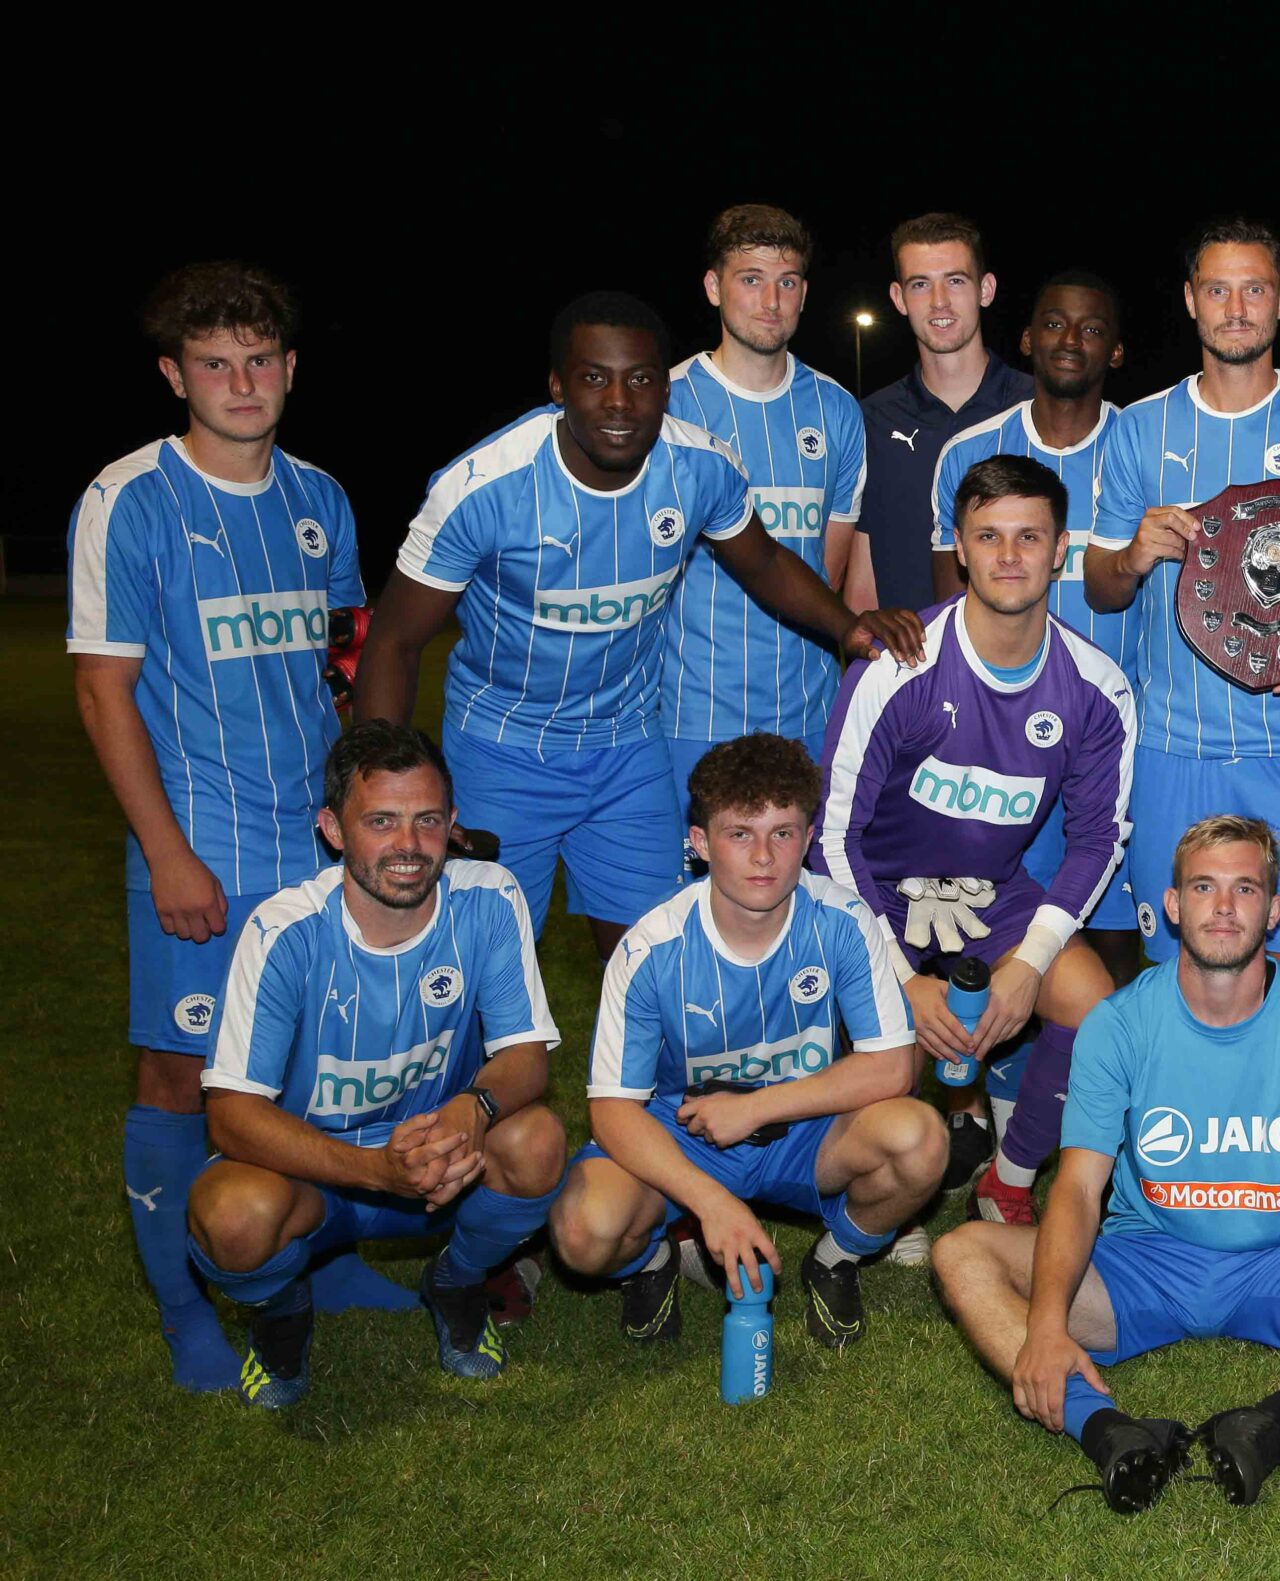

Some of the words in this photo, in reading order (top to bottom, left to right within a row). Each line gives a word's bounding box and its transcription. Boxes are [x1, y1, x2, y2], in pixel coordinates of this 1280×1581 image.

[299, 520, 319, 529] CHESTER
[655, 509, 676, 522] CHESTER
[754, 493, 821, 530] bna
[539, 582, 671, 625] mbna
[206, 602, 326, 652] mbna
[1034, 712, 1058, 722] CHESTER
[913, 766, 1036, 818] mbna
[427, 967, 455, 980] CHESTER
[795, 967, 820, 981] CHESTER
[315, 1045, 447, 1108] mbna
[692, 1041, 829, 1083] mbna
[753, 1353, 767, 1397] JAKO
